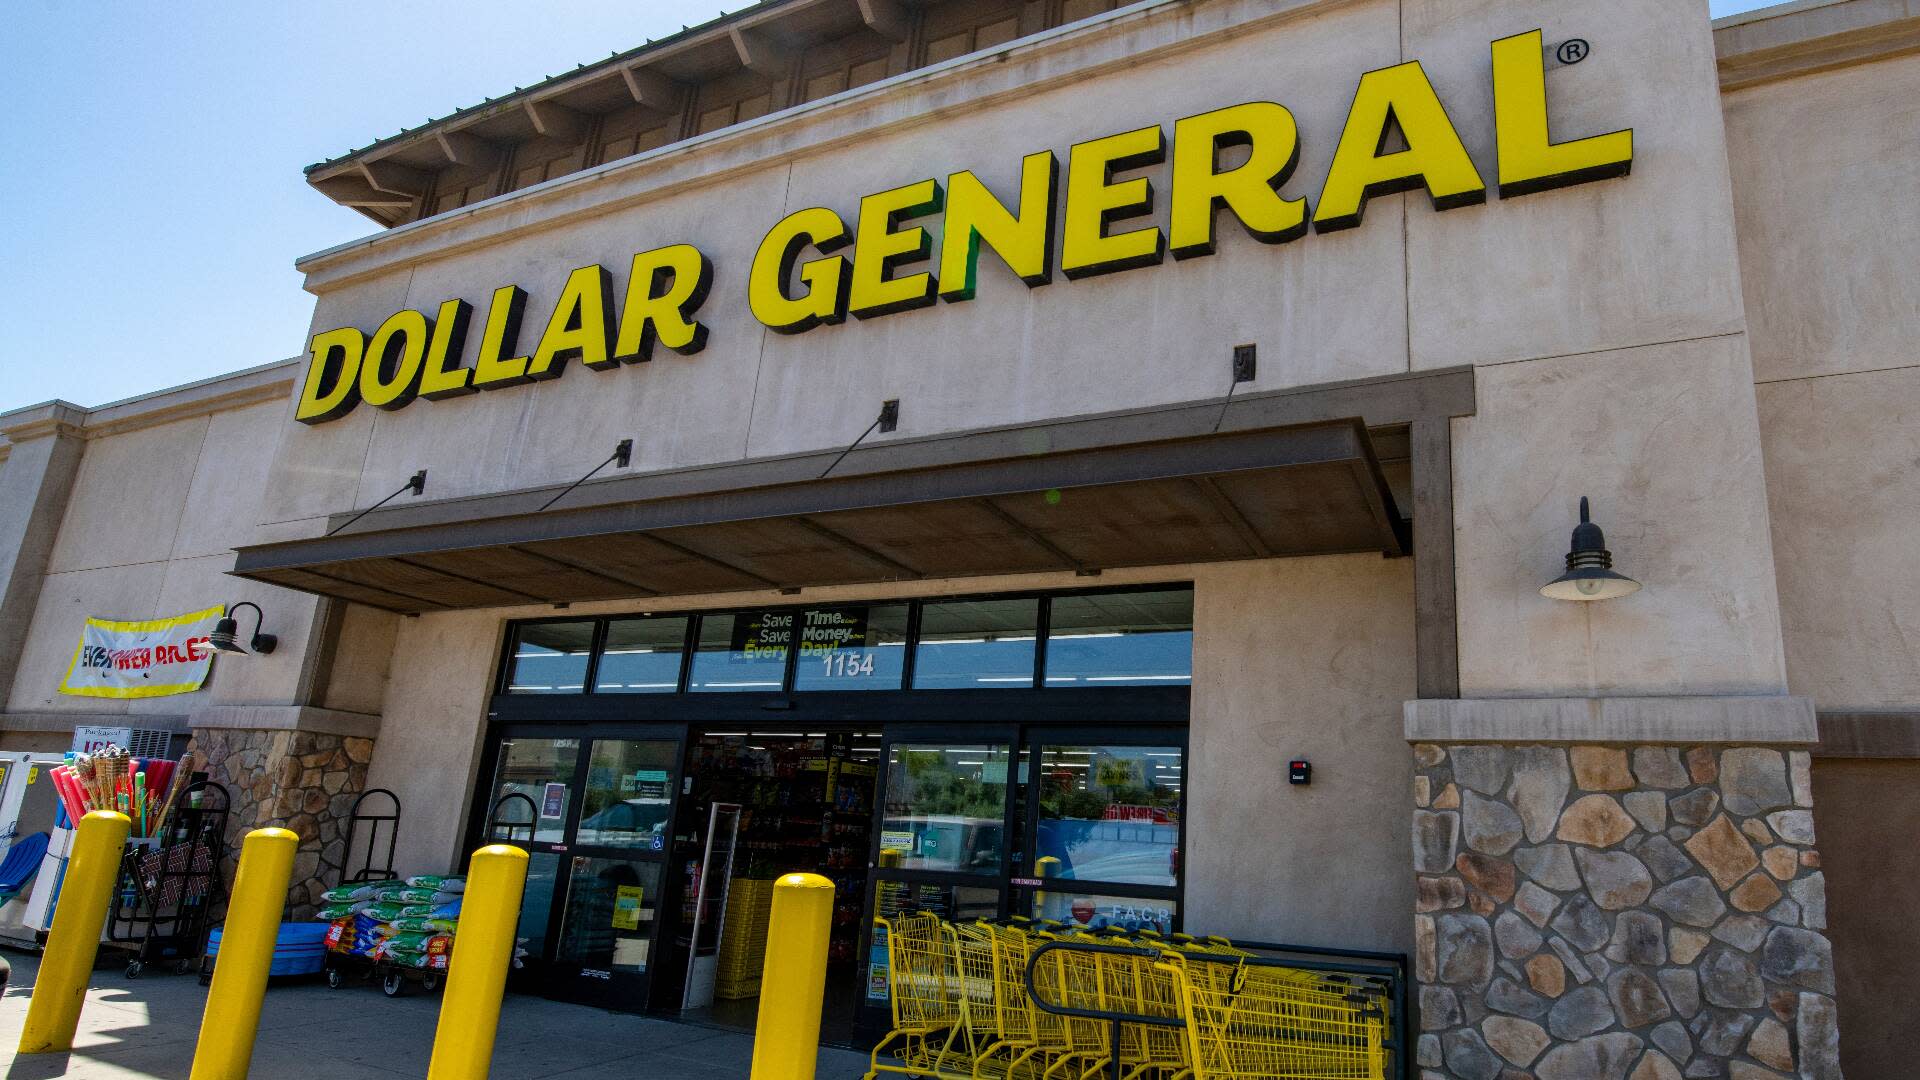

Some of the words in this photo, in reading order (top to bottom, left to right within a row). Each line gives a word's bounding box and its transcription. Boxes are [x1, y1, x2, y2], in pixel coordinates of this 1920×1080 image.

[295, 243, 712, 424] DOLLAR
[749, 29, 1633, 334] GENERAL
[762, 613, 792, 628] Save
[760, 629, 790, 643] Save
[744, 643, 788, 661] Every
[800, 640, 839, 659] Day!
[823, 653, 874, 677] 1154
